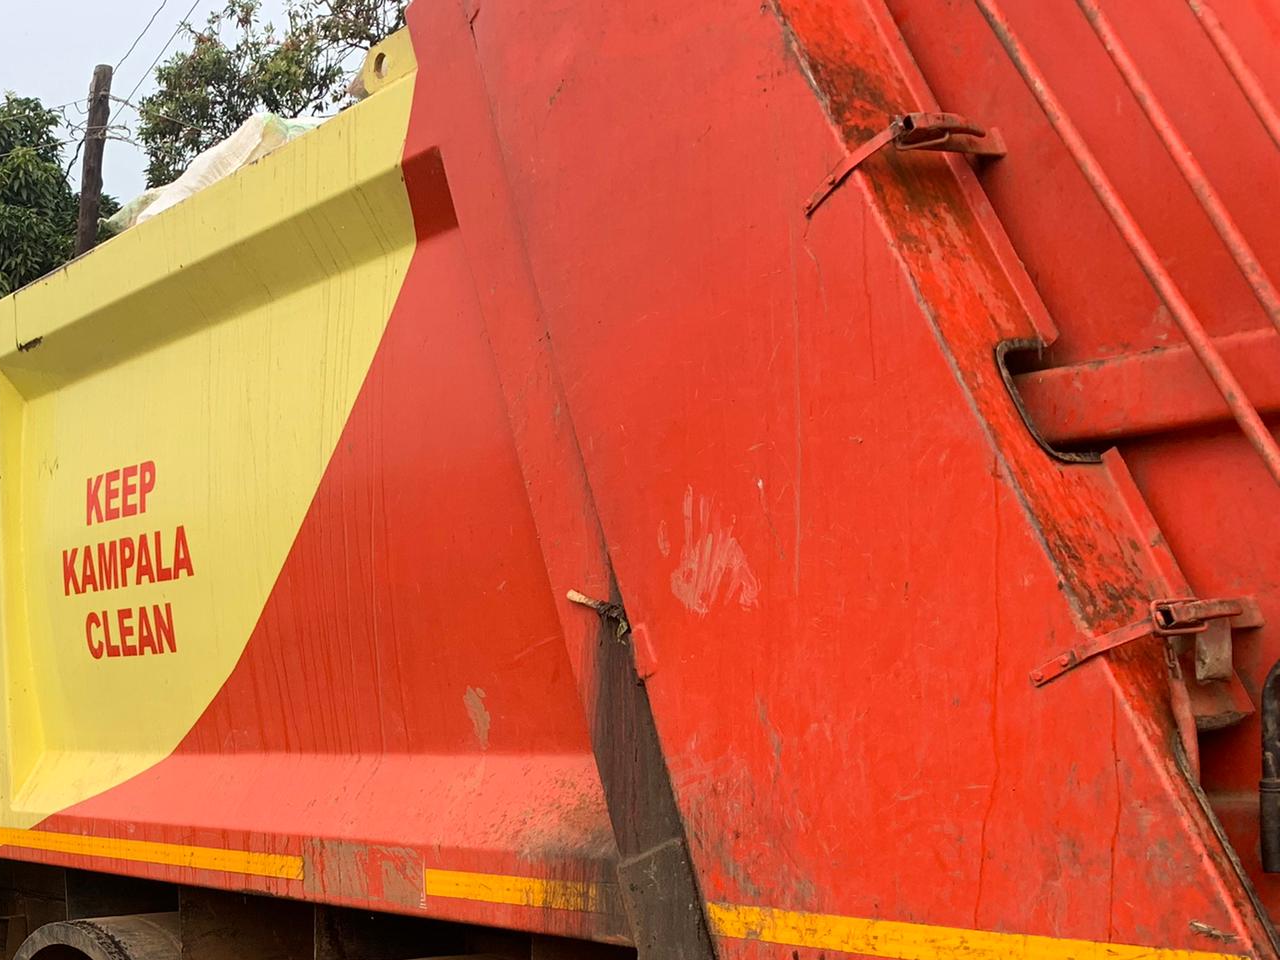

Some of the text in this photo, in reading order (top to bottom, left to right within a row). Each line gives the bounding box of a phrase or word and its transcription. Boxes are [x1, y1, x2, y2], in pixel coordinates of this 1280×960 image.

[86, 460, 156, 526] KEEP
[62, 525, 194, 596] KAMPALA
[85, 602, 177, 660] CLEAN
